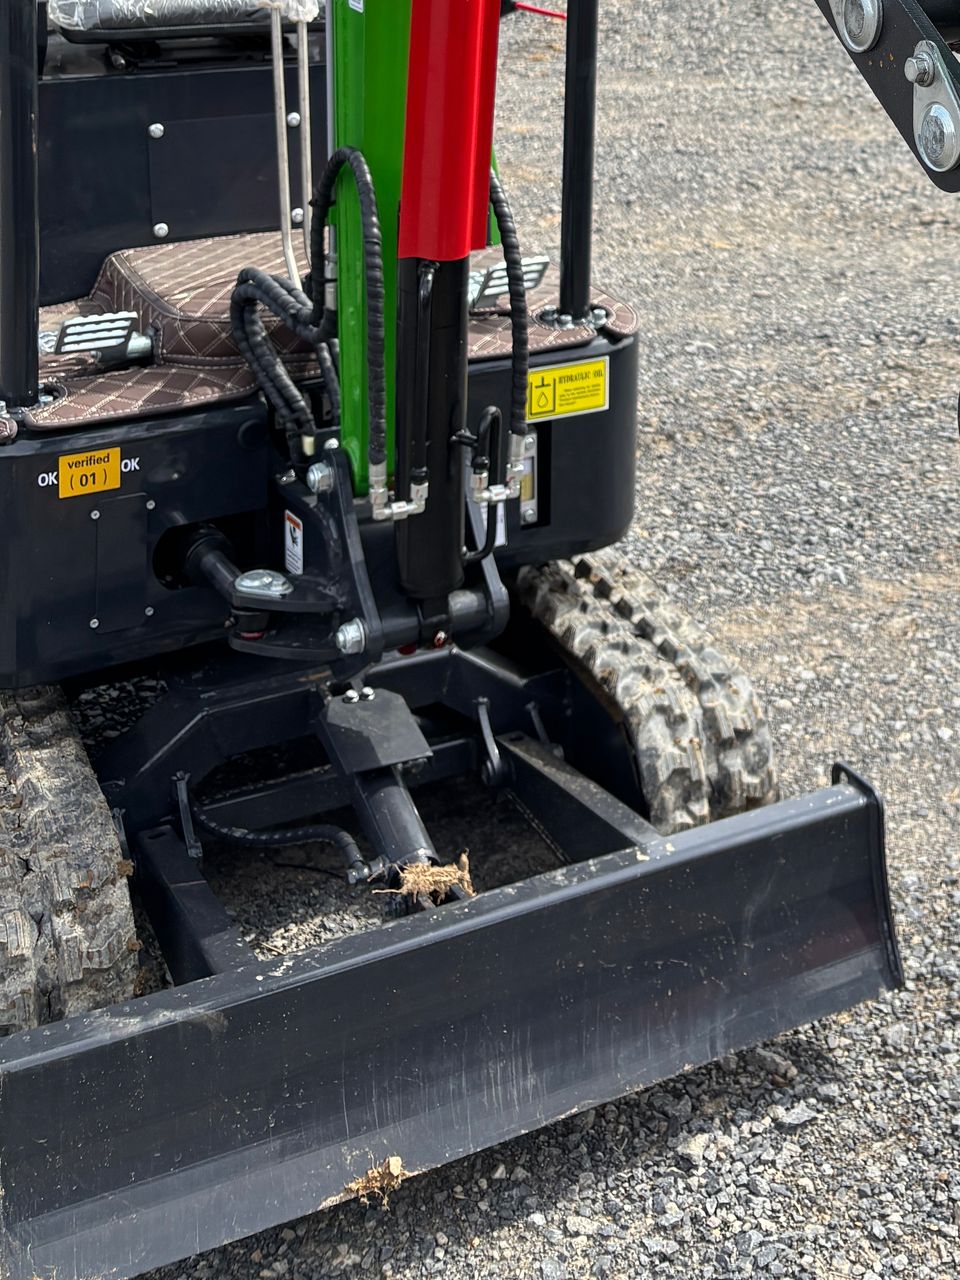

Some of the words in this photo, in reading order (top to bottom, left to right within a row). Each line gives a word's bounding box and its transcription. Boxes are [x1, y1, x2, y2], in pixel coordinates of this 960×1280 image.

[67, 452, 110, 469] verified
[121, 457, 140, 472] OK
[37, 471, 58, 487] OK
